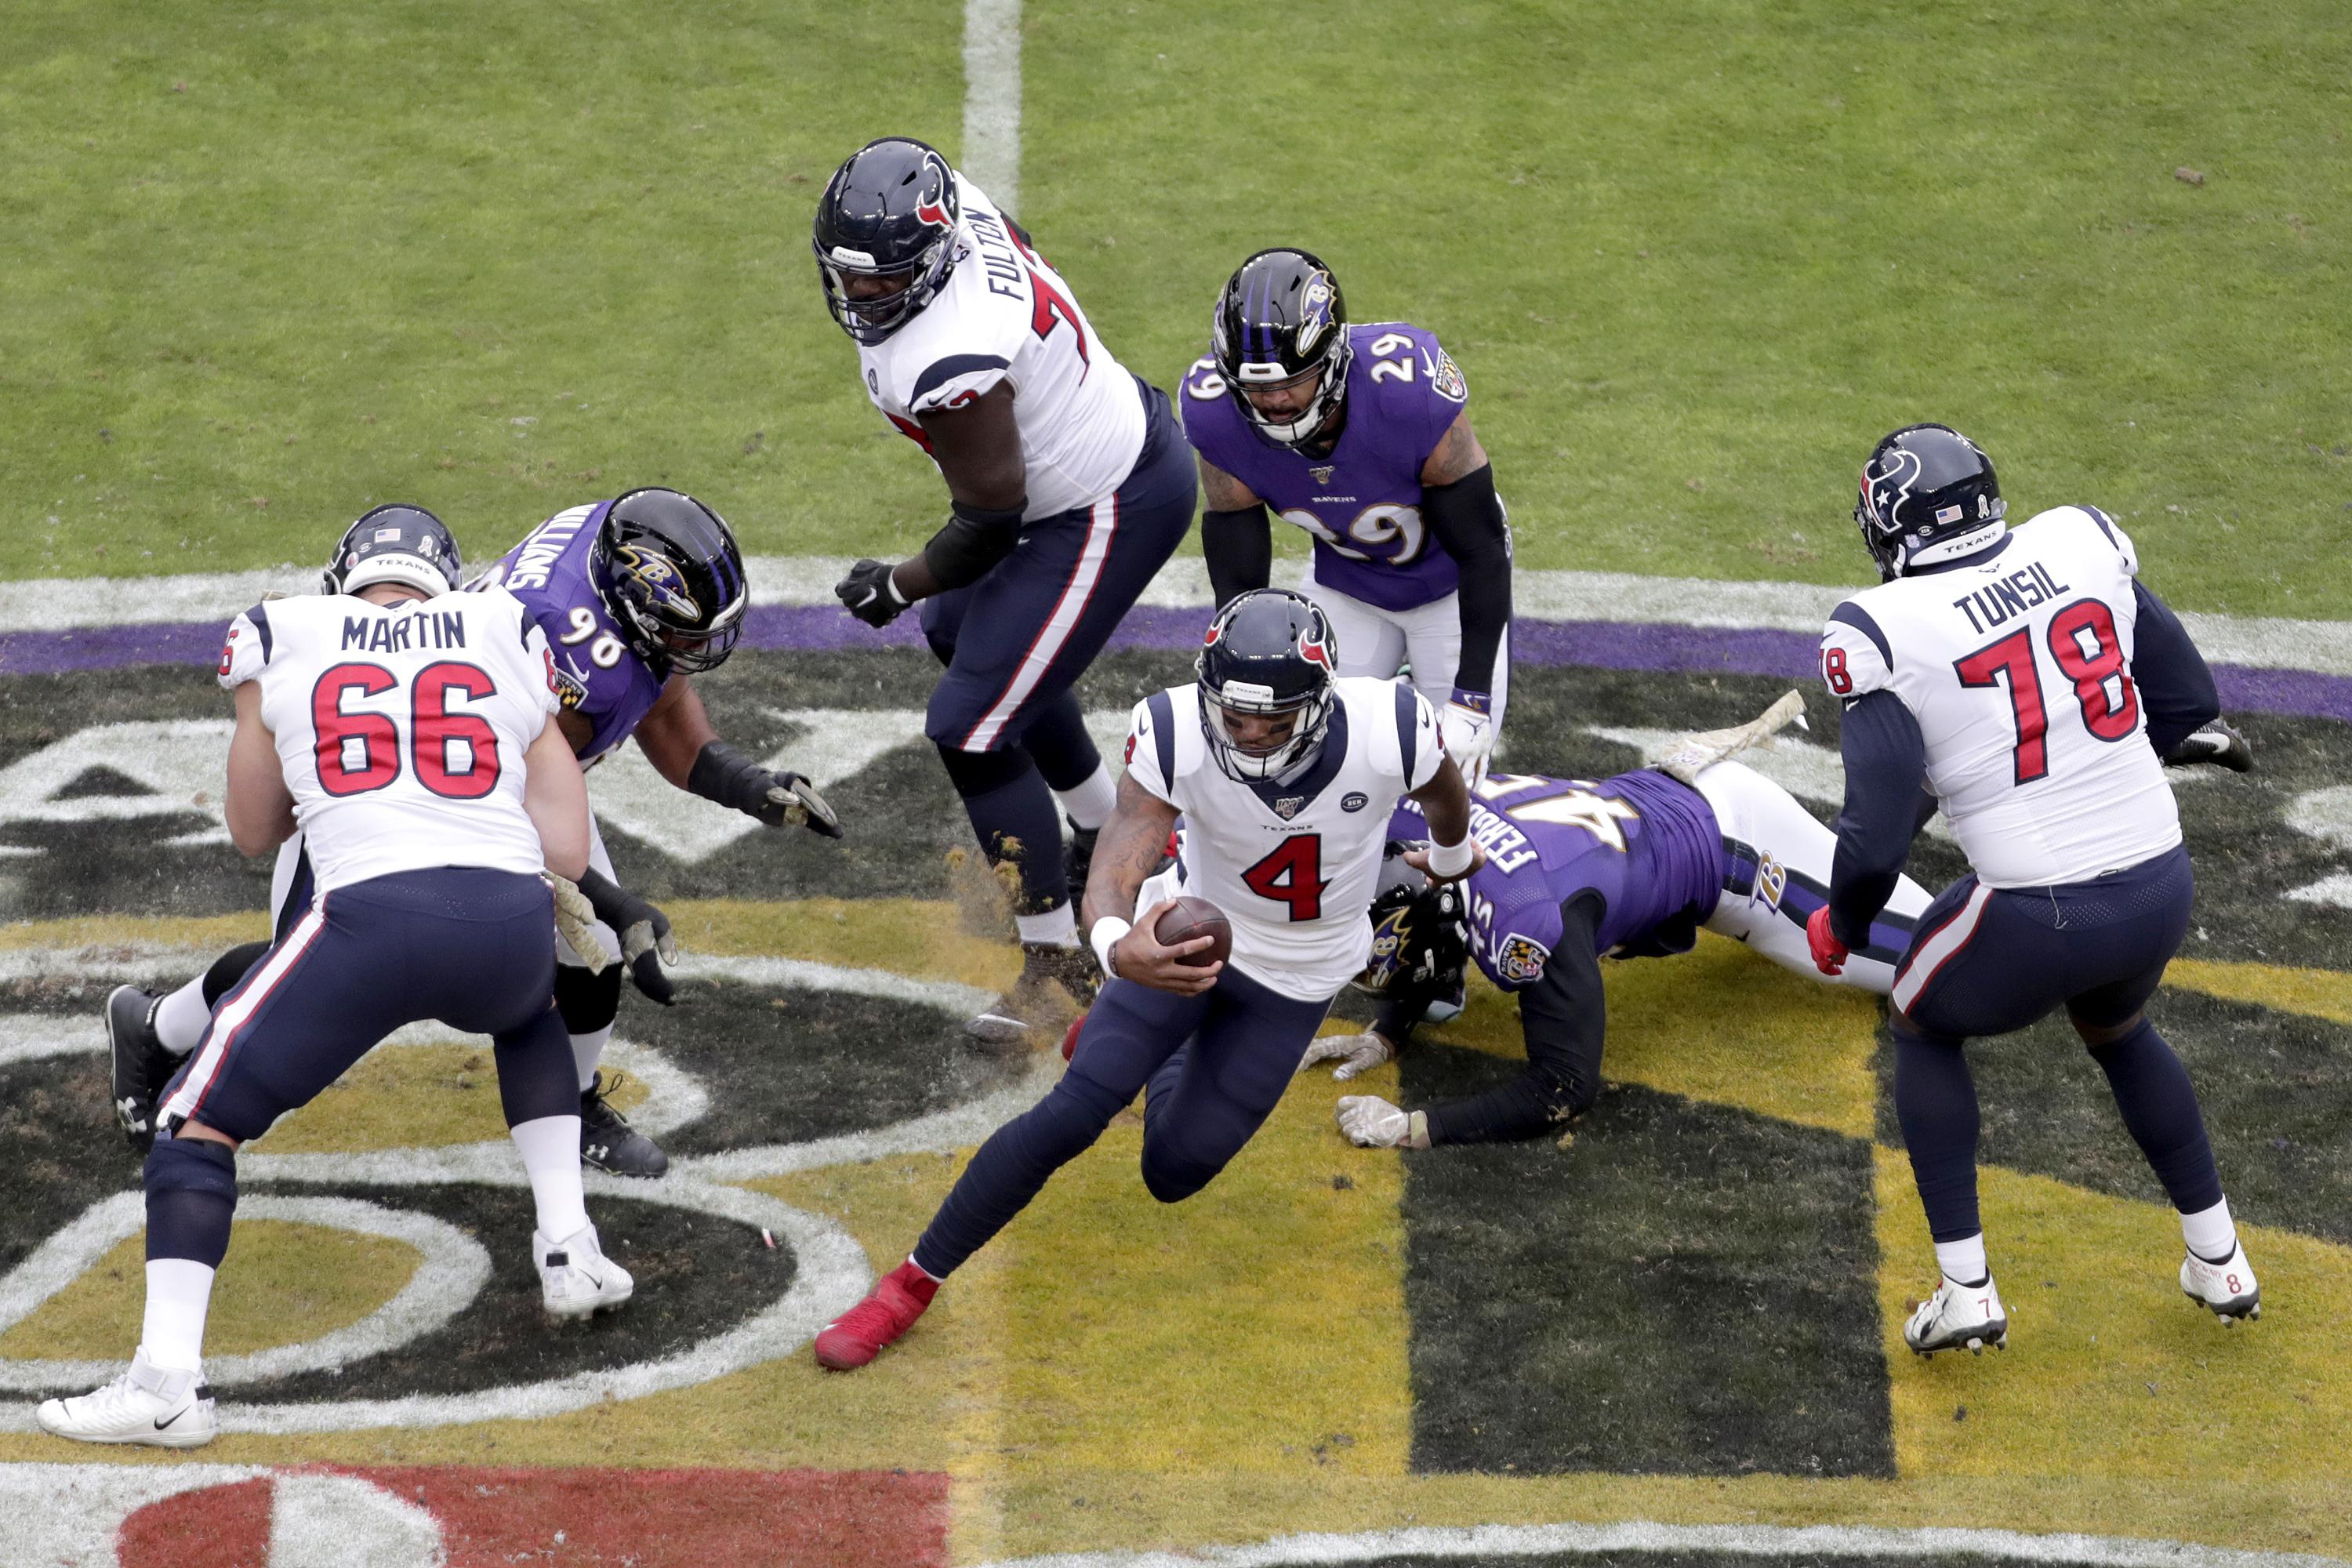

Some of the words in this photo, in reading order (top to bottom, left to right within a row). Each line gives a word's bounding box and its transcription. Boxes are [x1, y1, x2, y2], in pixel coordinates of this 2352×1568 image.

[962, 206, 1024, 301] FULTON
[1370, 332, 1415, 385] 29
[376, 558, 430, 575] TEXANS
[1944, 531, 1997, 553] TEXANS
[1953, 561, 2070, 634] TUNSIL
[342, 611, 466, 653] MARTIN
[1952, 597, 2139, 787] 78
[310, 660, 501, 799] 66
[1240, 833, 1334, 922] 4
[1977, 1298, 1991, 1319] 7
[2227, 1273, 2242, 1294] 8
